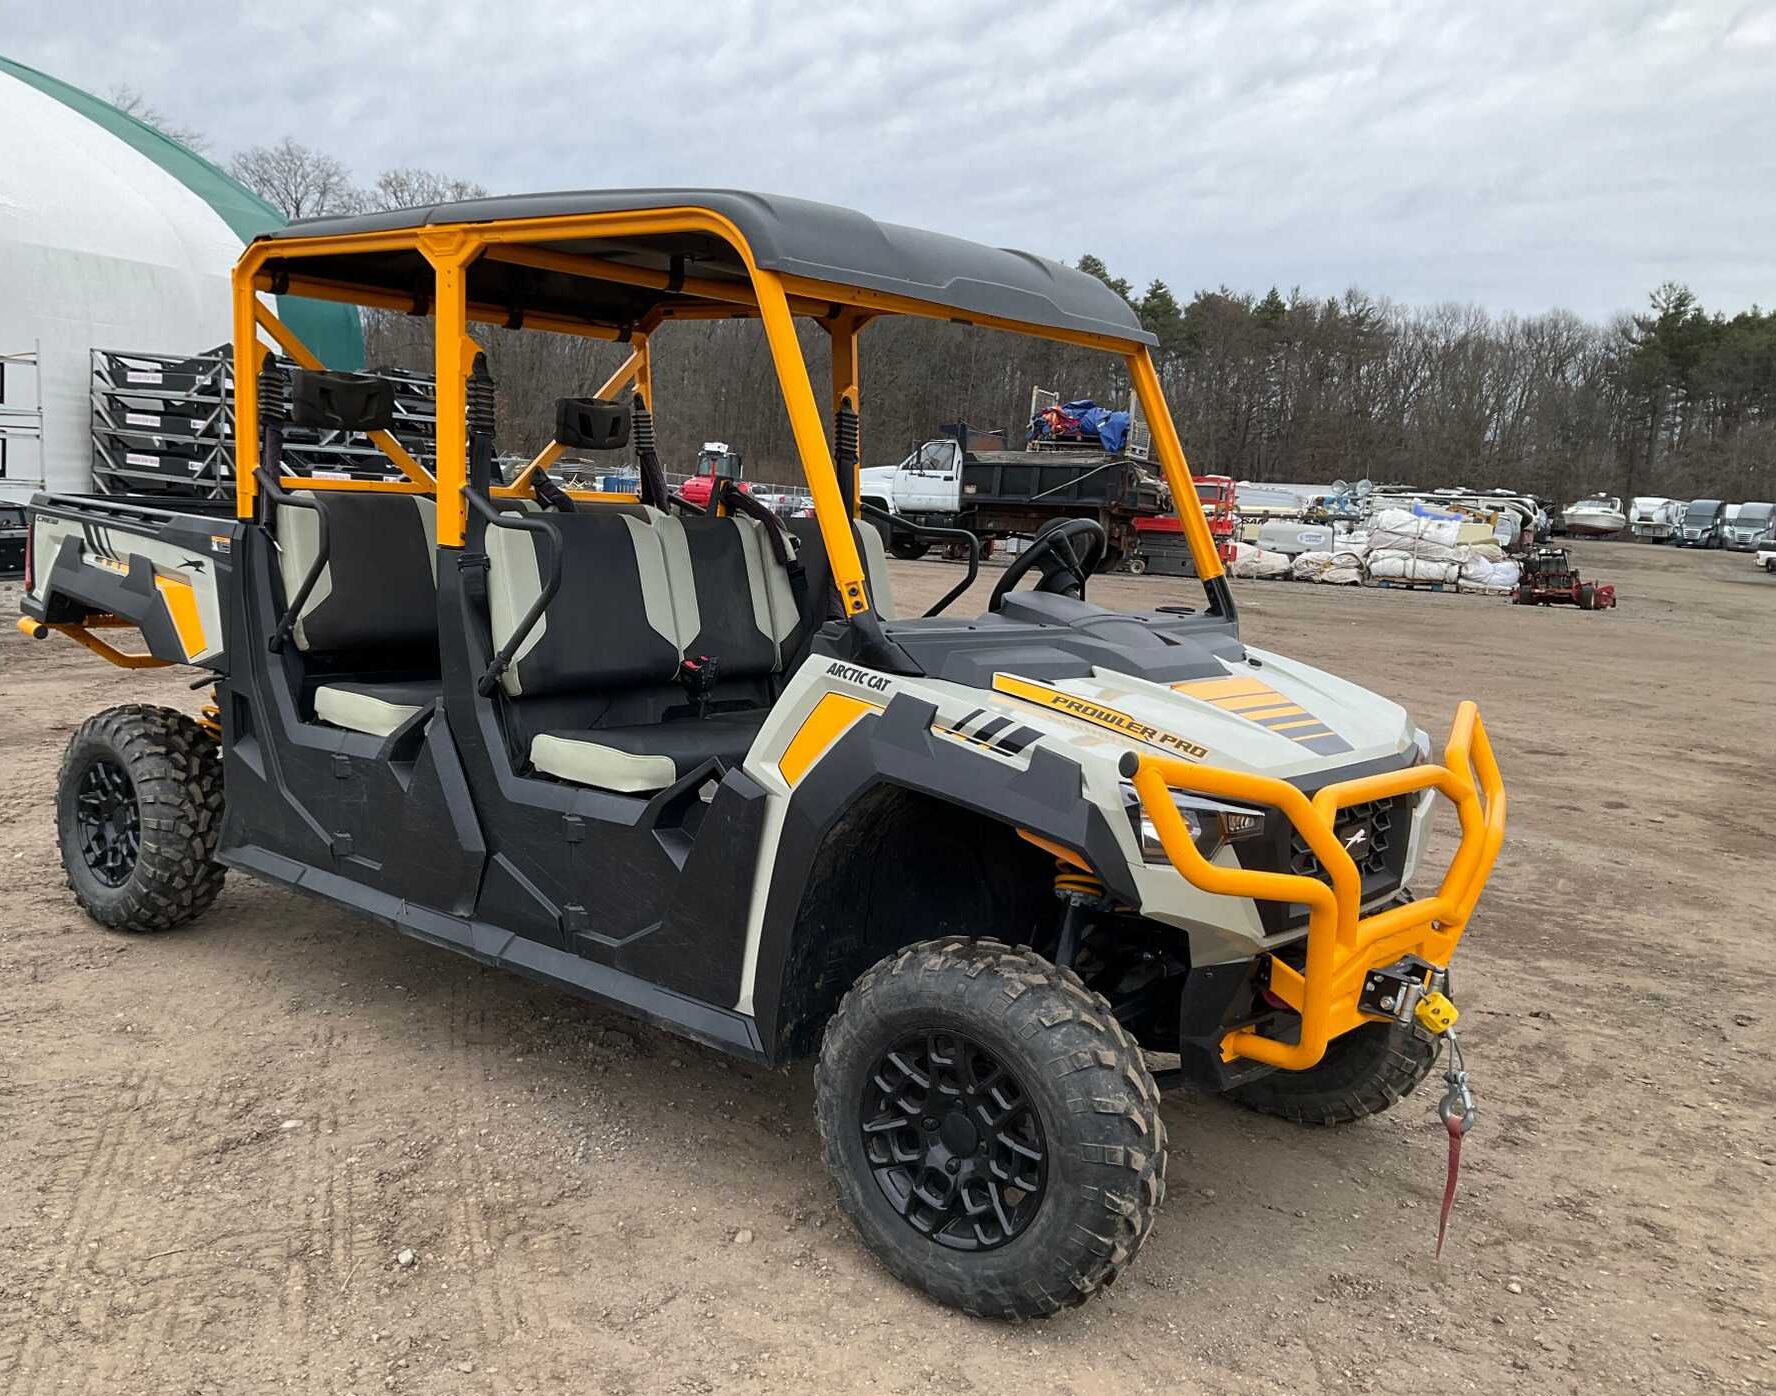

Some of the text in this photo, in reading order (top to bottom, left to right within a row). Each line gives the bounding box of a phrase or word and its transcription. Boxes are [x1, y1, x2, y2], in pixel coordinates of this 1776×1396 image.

[36, 515, 59, 525] CREW
[826, 662, 892, 691] ARCTIC CAT
[1051, 696, 1209, 758] PROWLER PRO
